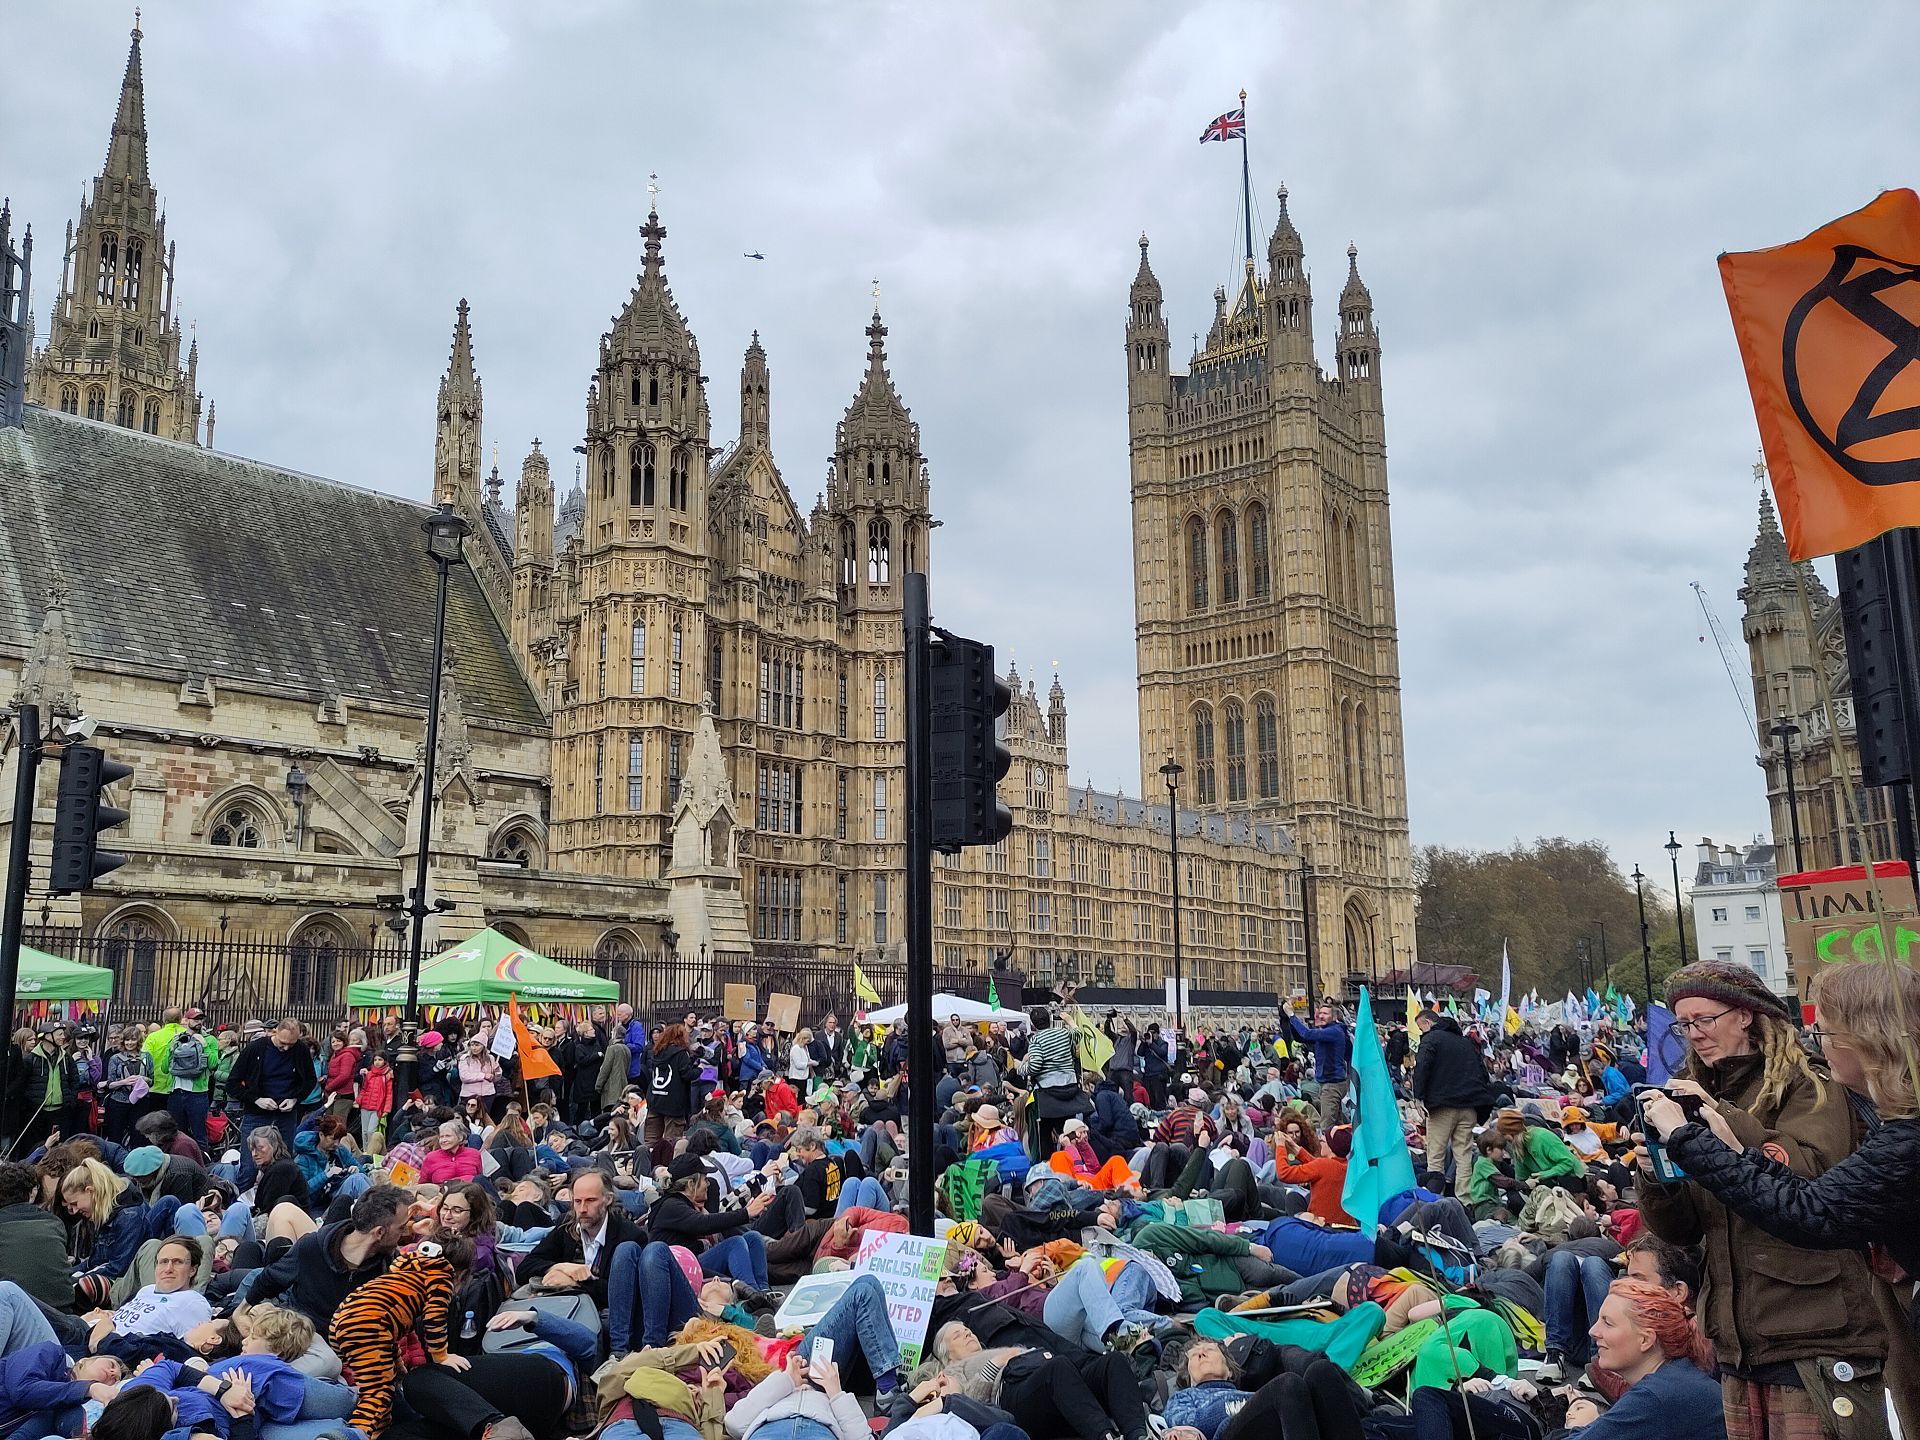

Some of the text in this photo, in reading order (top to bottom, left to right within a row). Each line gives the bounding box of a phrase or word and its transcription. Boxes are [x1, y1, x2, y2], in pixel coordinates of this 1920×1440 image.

[521, 985, 585, 998] GREENPEACE
[859, 1232, 889, 1266] FACT
[896, 1240, 924, 1257] ALL
[927, 1251, 940, 1260] STOP
[868, 1256, 921, 1279] ENGLISH
[910, 1285, 936, 1302] ARE
[903, 1348, 917, 1358] STOP
[903, 1357, 913, 1365] THE
